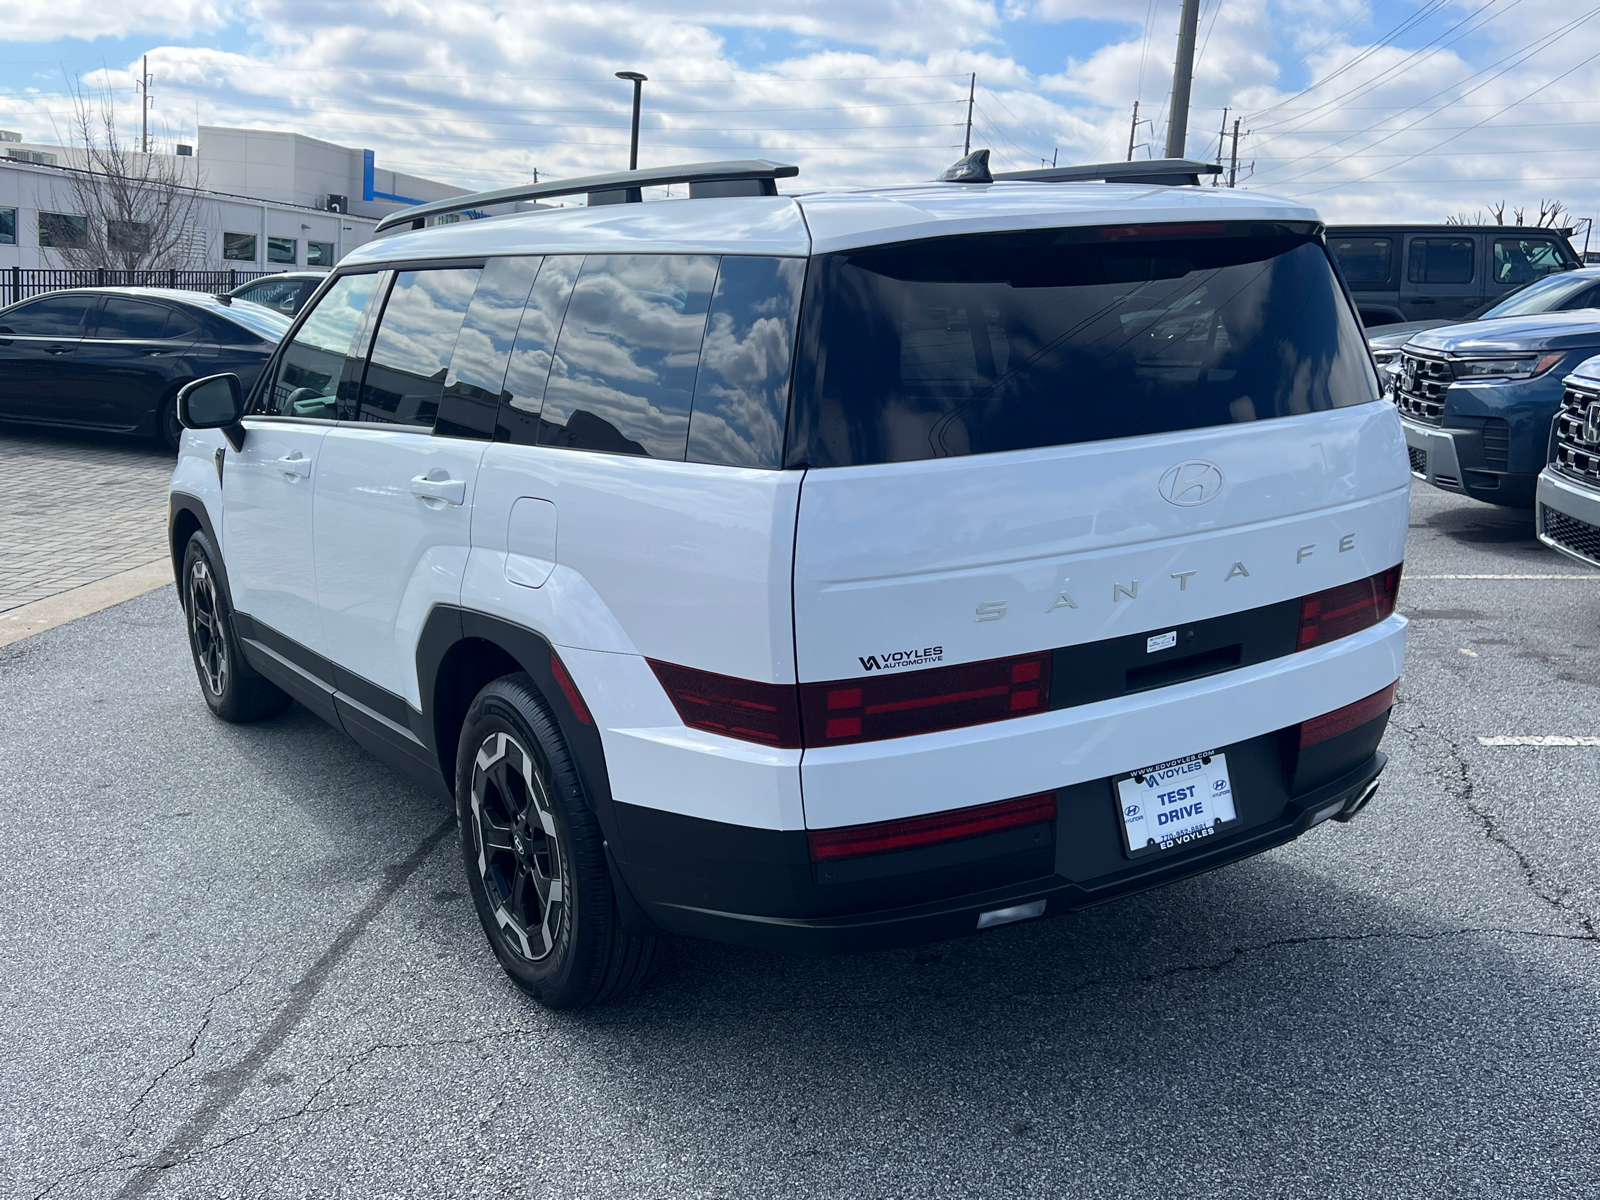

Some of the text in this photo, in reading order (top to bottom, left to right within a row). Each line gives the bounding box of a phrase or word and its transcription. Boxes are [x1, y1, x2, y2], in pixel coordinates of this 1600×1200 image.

[975, 533, 1356, 623] SANTA FE
[880, 645, 943, 663] VOYLES
[883, 655, 943, 670] AUTOMOTIVE
[1130, 749, 1215, 777] WWW.EDVOYLES.COM
[1158, 761, 1202, 781] VOYLES
[1157, 785, 1195, 806] TEST
[1157, 802, 1204, 826] DRIVE
[1160, 827, 1215, 850] ED VOYLES
